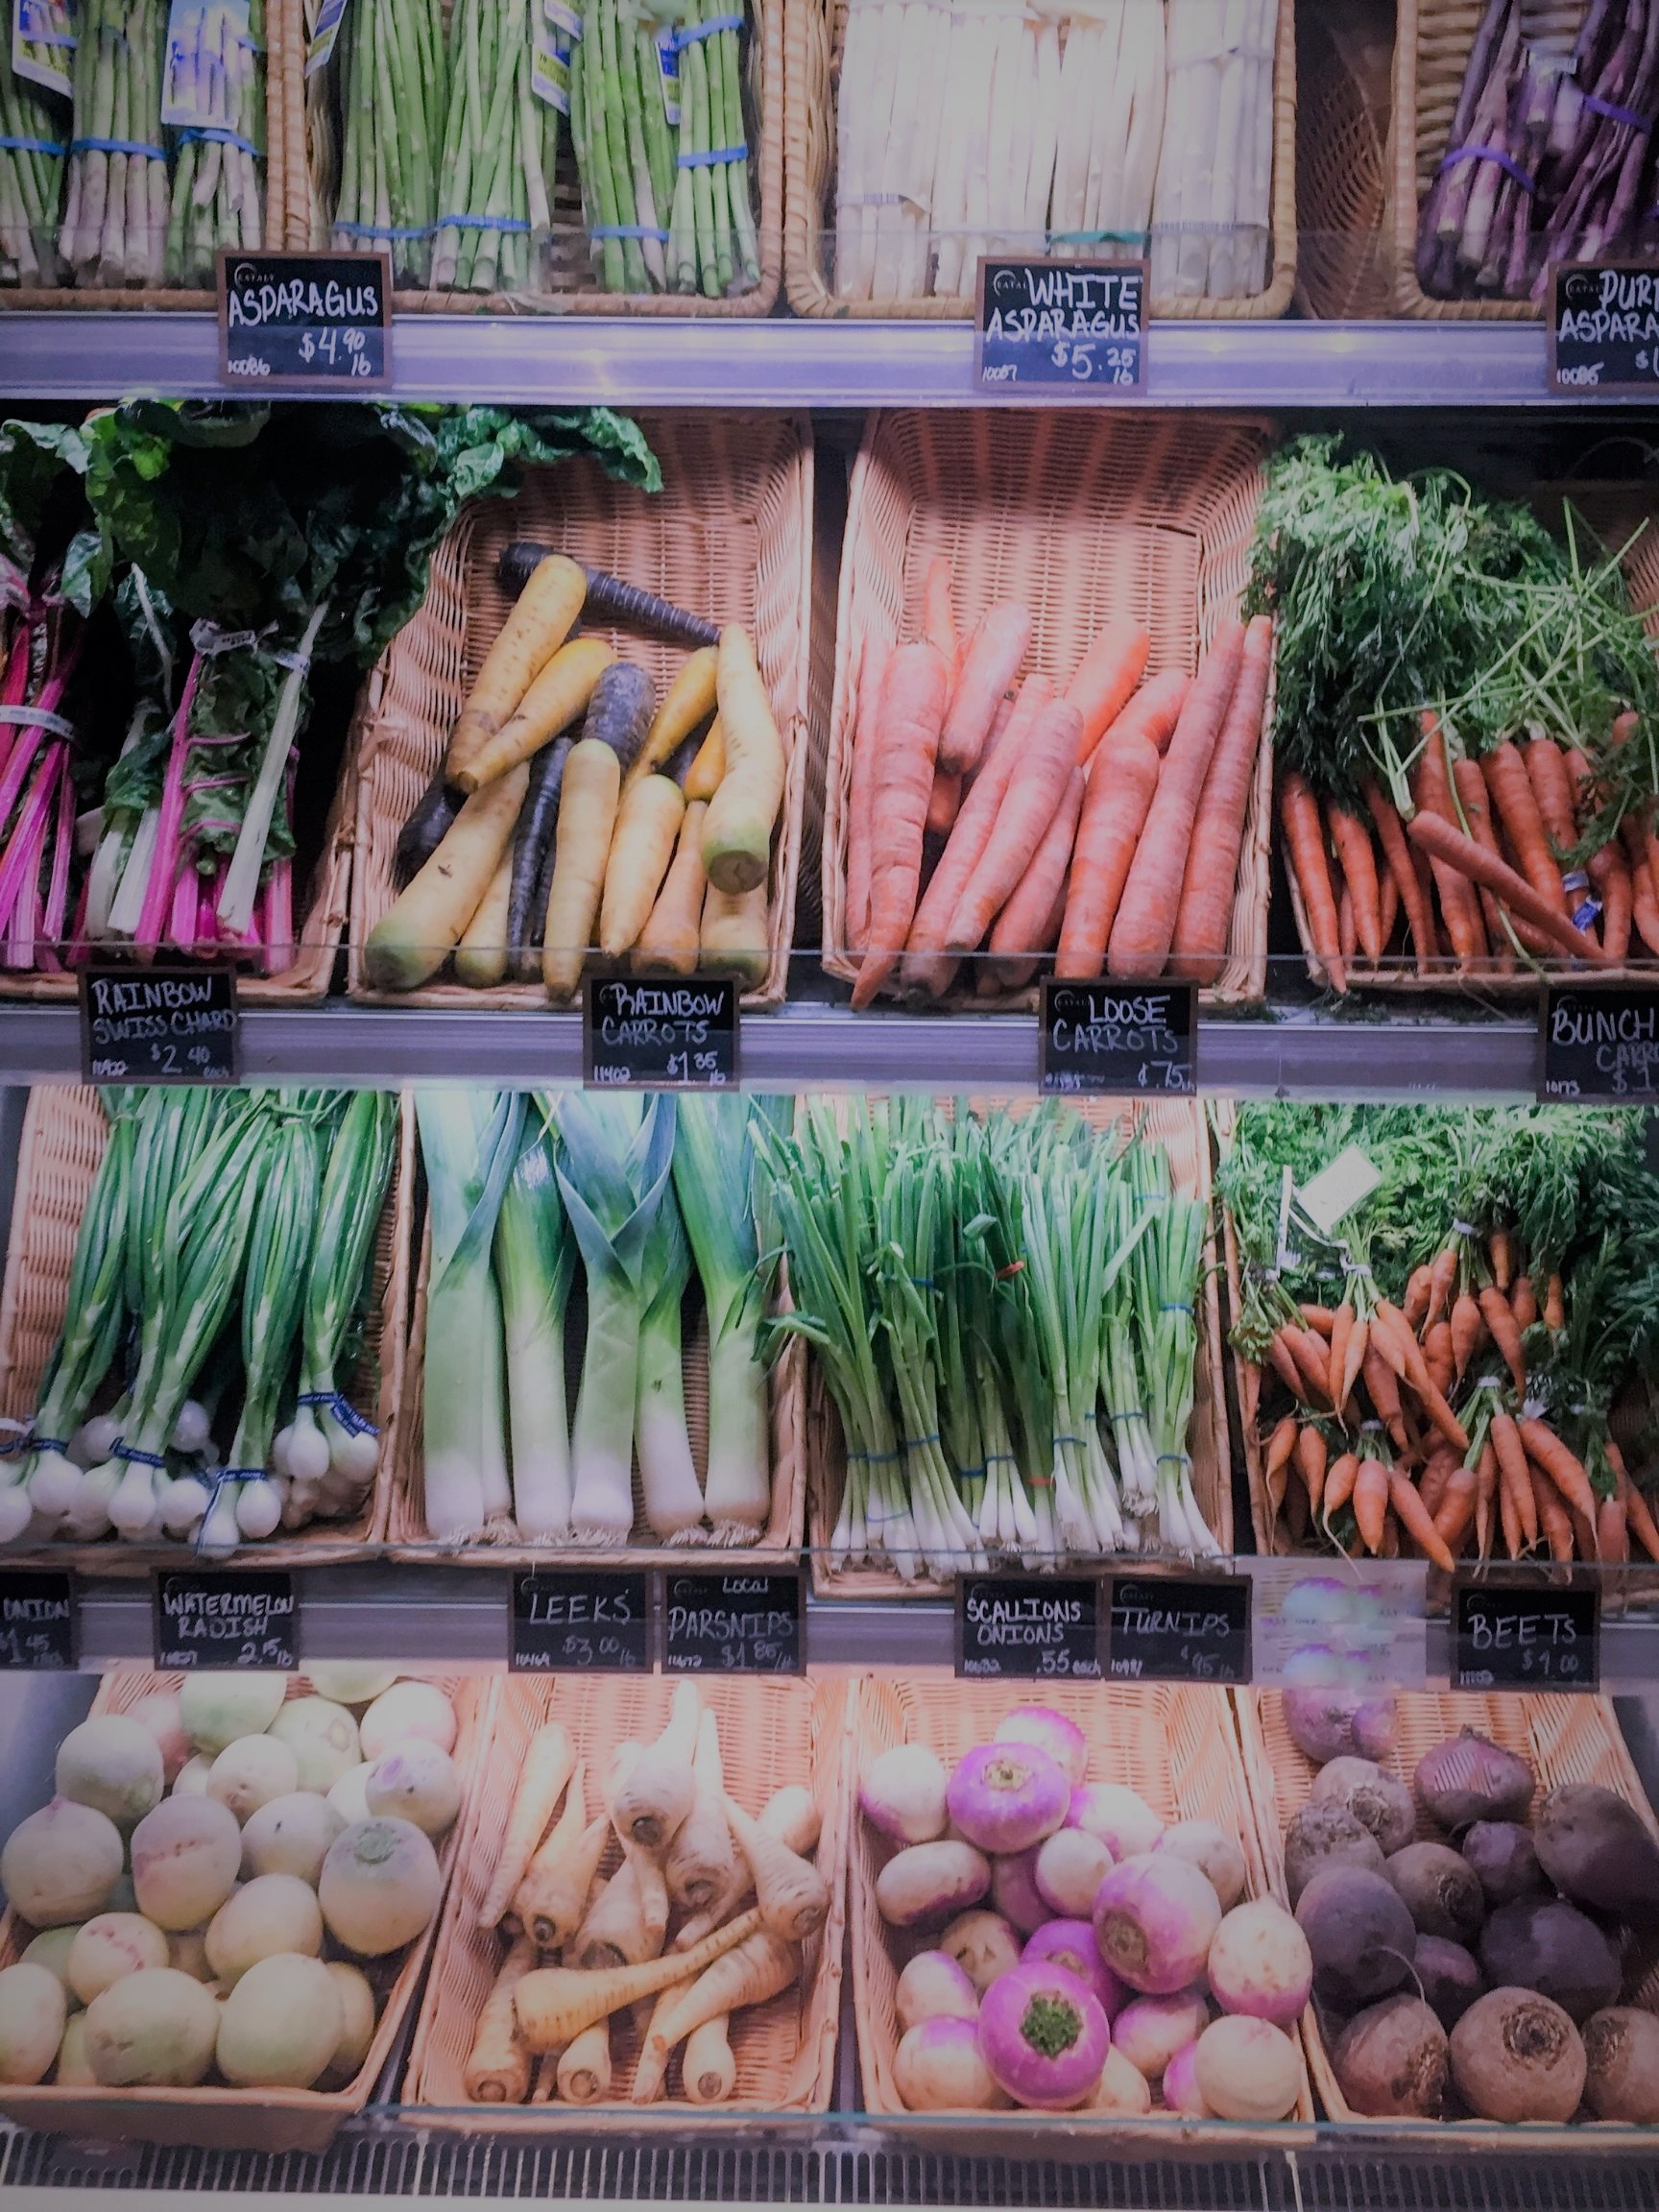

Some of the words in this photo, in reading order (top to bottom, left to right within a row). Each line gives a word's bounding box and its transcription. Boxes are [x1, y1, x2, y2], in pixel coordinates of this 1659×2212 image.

[228, 278, 379, 327] ASPARAGUS
[1024, 268, 1140, 310] WHITE
[985, 307, 1141, 343] ASPARAGUS
[298, 326, 367, 365] $4.90
[350, 352, 373, 376] lb
[91, 975, 212, 1015] RAINBOW
[610, 982, 725, 1017] RAINBOW
[1088, 994, 1171, 1025] LOOSE
[92, 1015, 168, 1046] SWISS
[170, 1008, 238, 1037] CHARD
[601, 1015, 711, 1047] CARROTS
[1052, 1018, 1179, 1054] CARROTS
[1551, 1007, 1655, 1047] BUNCH
[530, 1592, 631, 1625] LEEKS
[668, 1605, 794, 1642] PARSNIPS
[967, 1598, 1082, 1625] SCALLIONS
[1111, 1606, 1230, 1639] TURNIPS
[178, 1614, 269, 1640] RADISH
[977, 1623, 1065, 1647] ONIONS
[1467, 1613, 1576, 1650] BEETS
